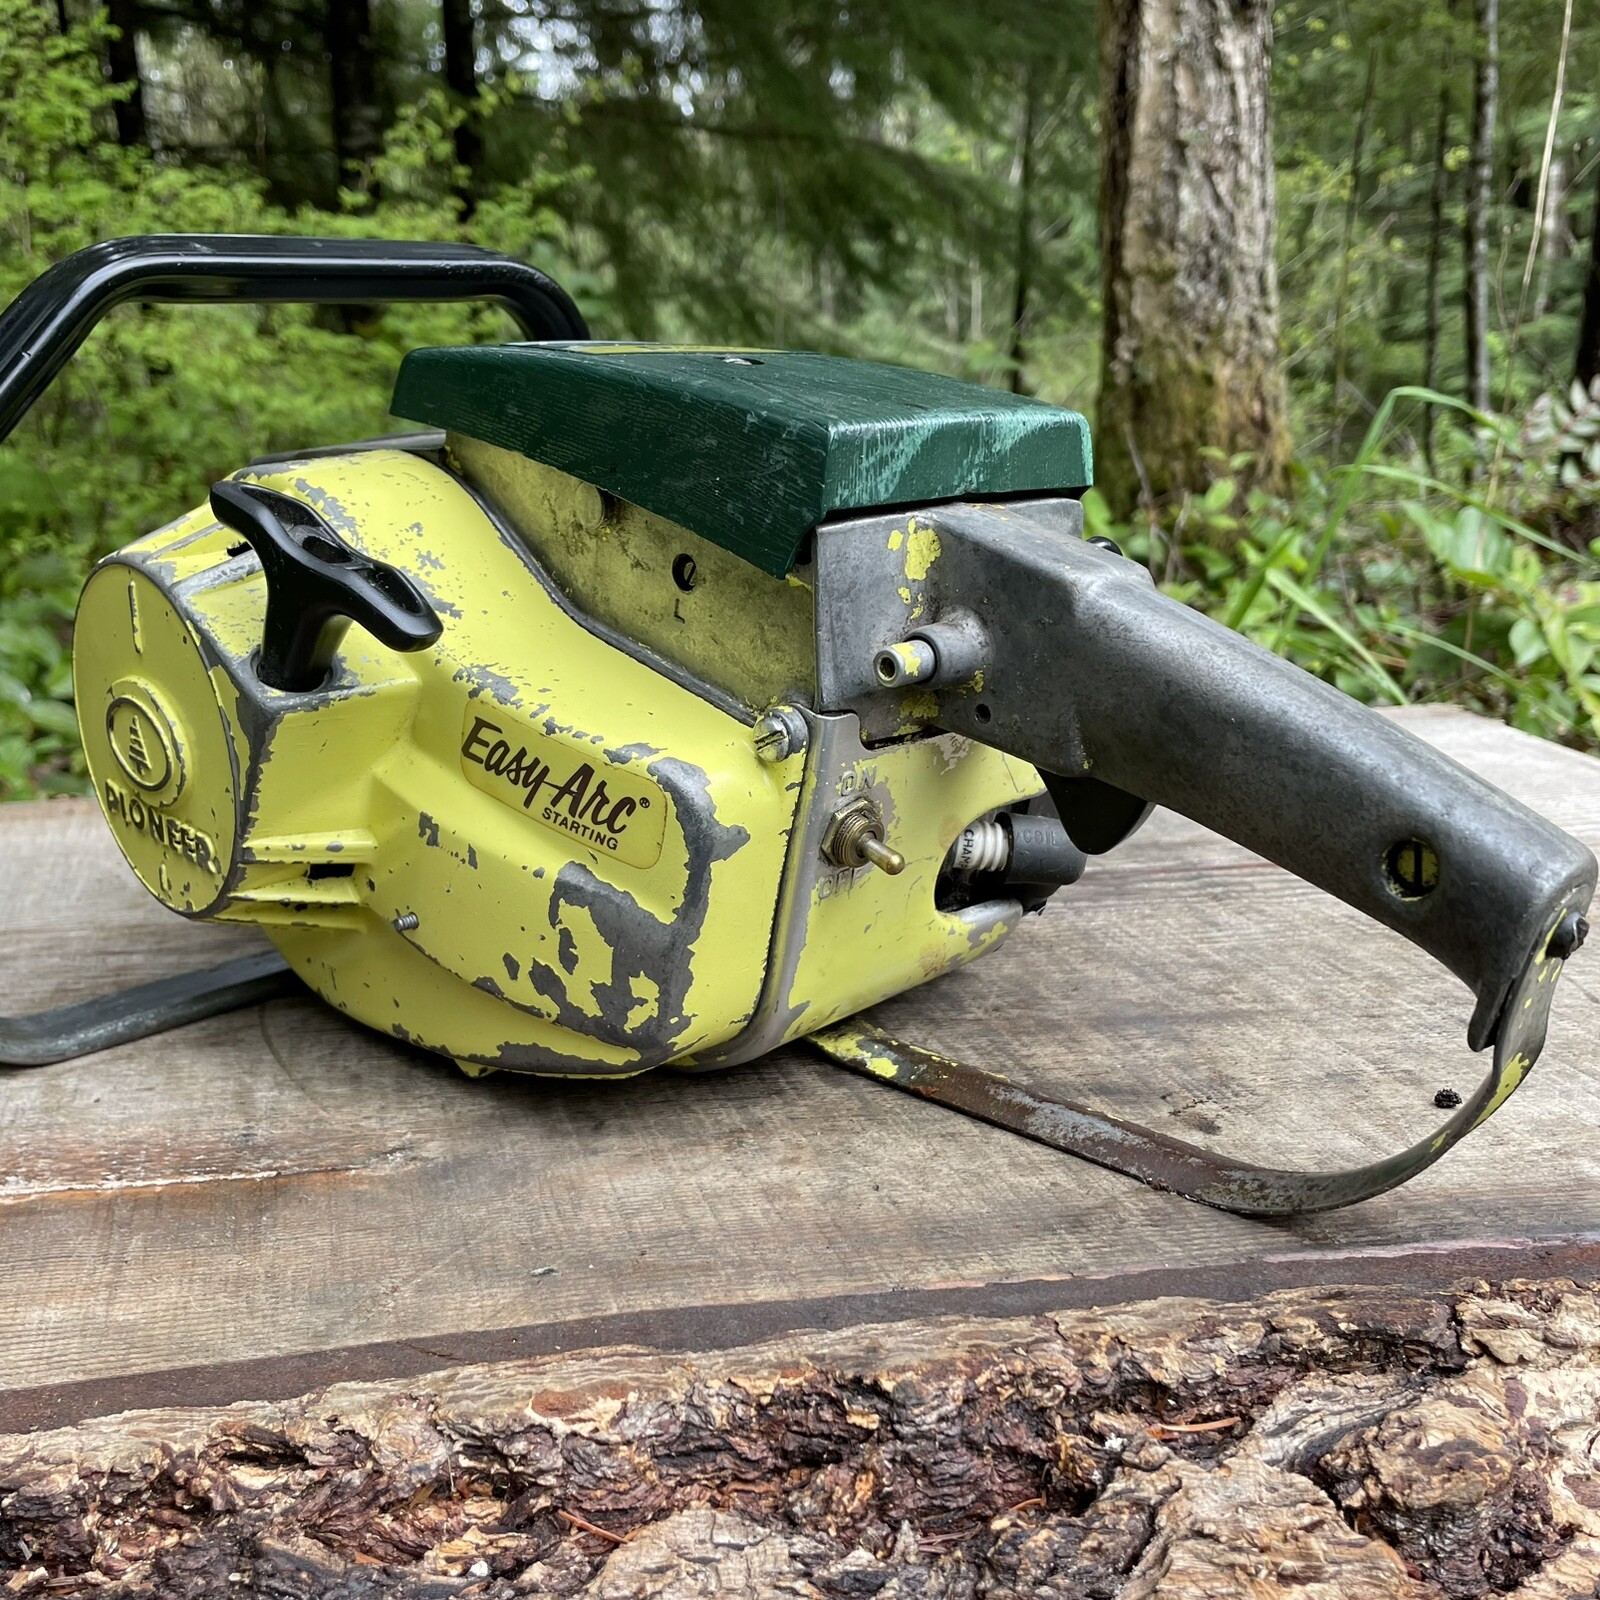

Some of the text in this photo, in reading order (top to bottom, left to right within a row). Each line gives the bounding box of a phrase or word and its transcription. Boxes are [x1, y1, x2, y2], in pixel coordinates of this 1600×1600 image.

[840, 765, 877, 796] ON
[104, 777, 220, 876] PIONEER
[541, 806, 619, 851] STARTING
